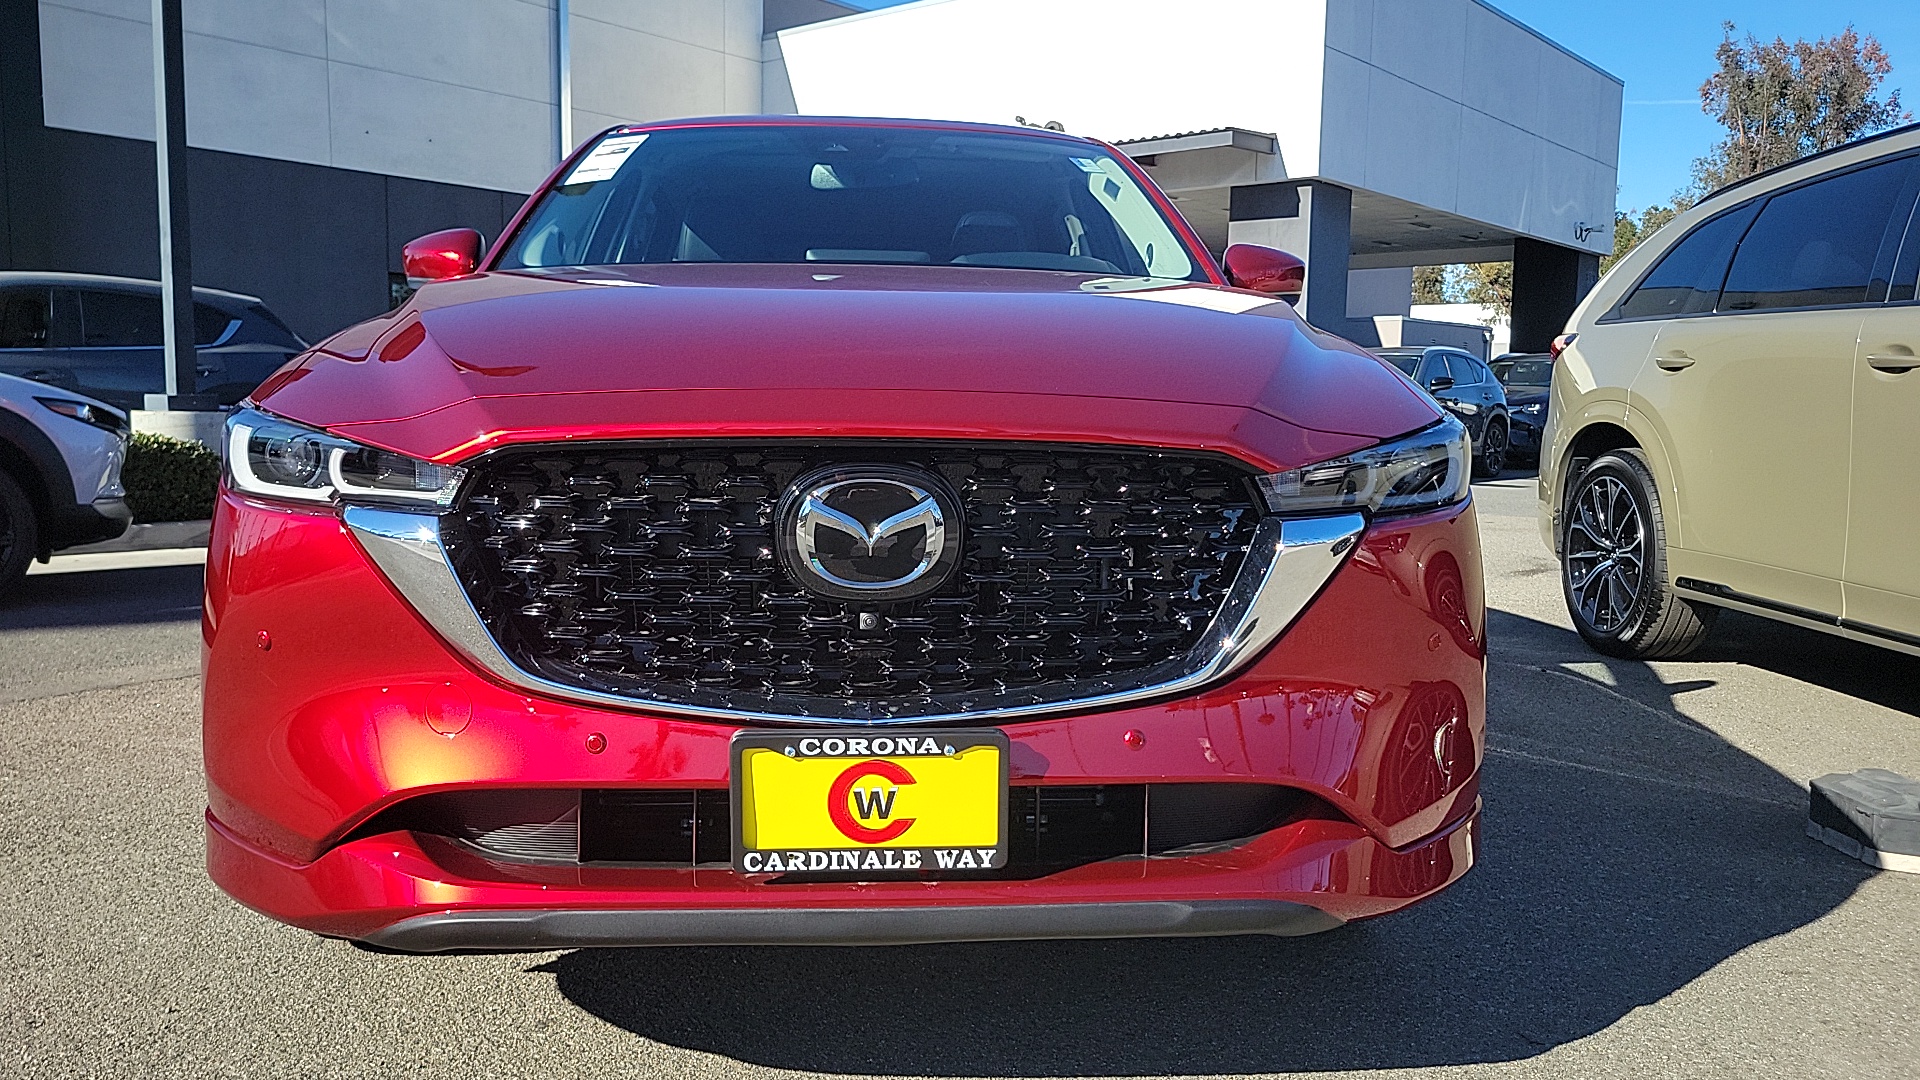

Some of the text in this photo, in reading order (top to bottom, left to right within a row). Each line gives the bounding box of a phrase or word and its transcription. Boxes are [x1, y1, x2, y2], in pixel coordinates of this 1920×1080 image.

[799, 737, 942, 756] CORONA
[743, 849, 997, 872] CARDINALE WAY
